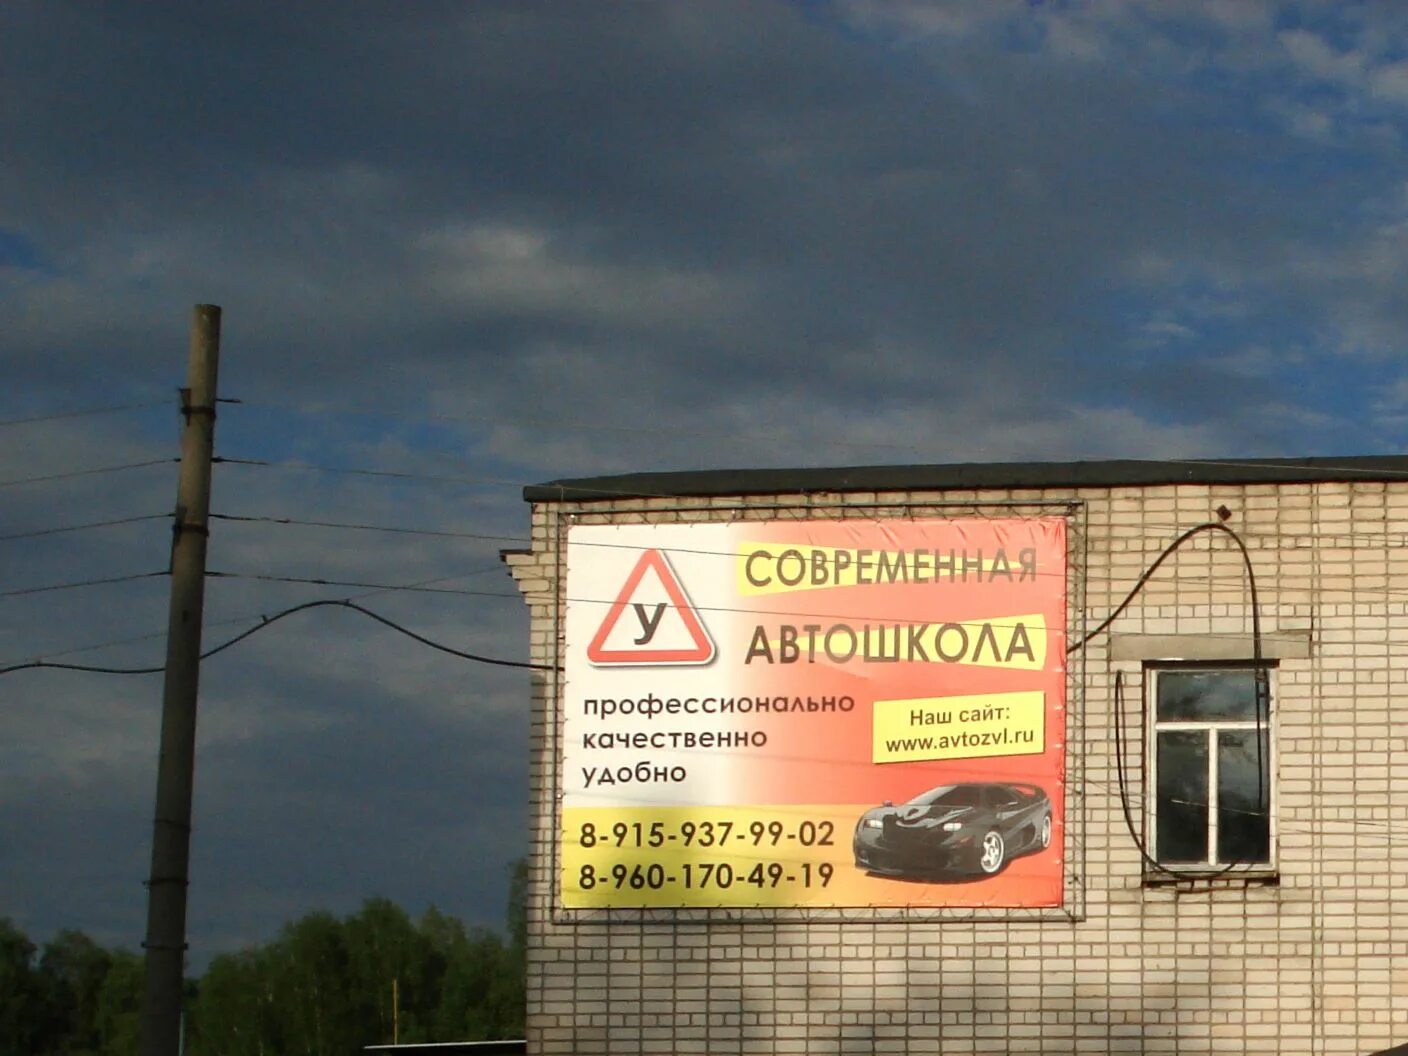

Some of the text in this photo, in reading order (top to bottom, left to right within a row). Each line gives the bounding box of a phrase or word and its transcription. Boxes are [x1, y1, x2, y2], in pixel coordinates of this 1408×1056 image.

[745, 547, 1038, 588] СОВРЕМЕННАЯ
[633, 602, 668, 646] У
[744, 622, 1036, 665] АВТОШКОЛА
[583, 693, 855, 718] профессионально
[910, 704, 1011, 727] Наш сайт:
[582, 729, 768, 750] качественно
[886, 728, 1035, 752] www.avtozvl.ru
[581, 761, 688, 787] удобно
[579, 821, 835, 849] 8-915-937-99-02
[579, 863, 835, 891] 8-960-170-49-19
